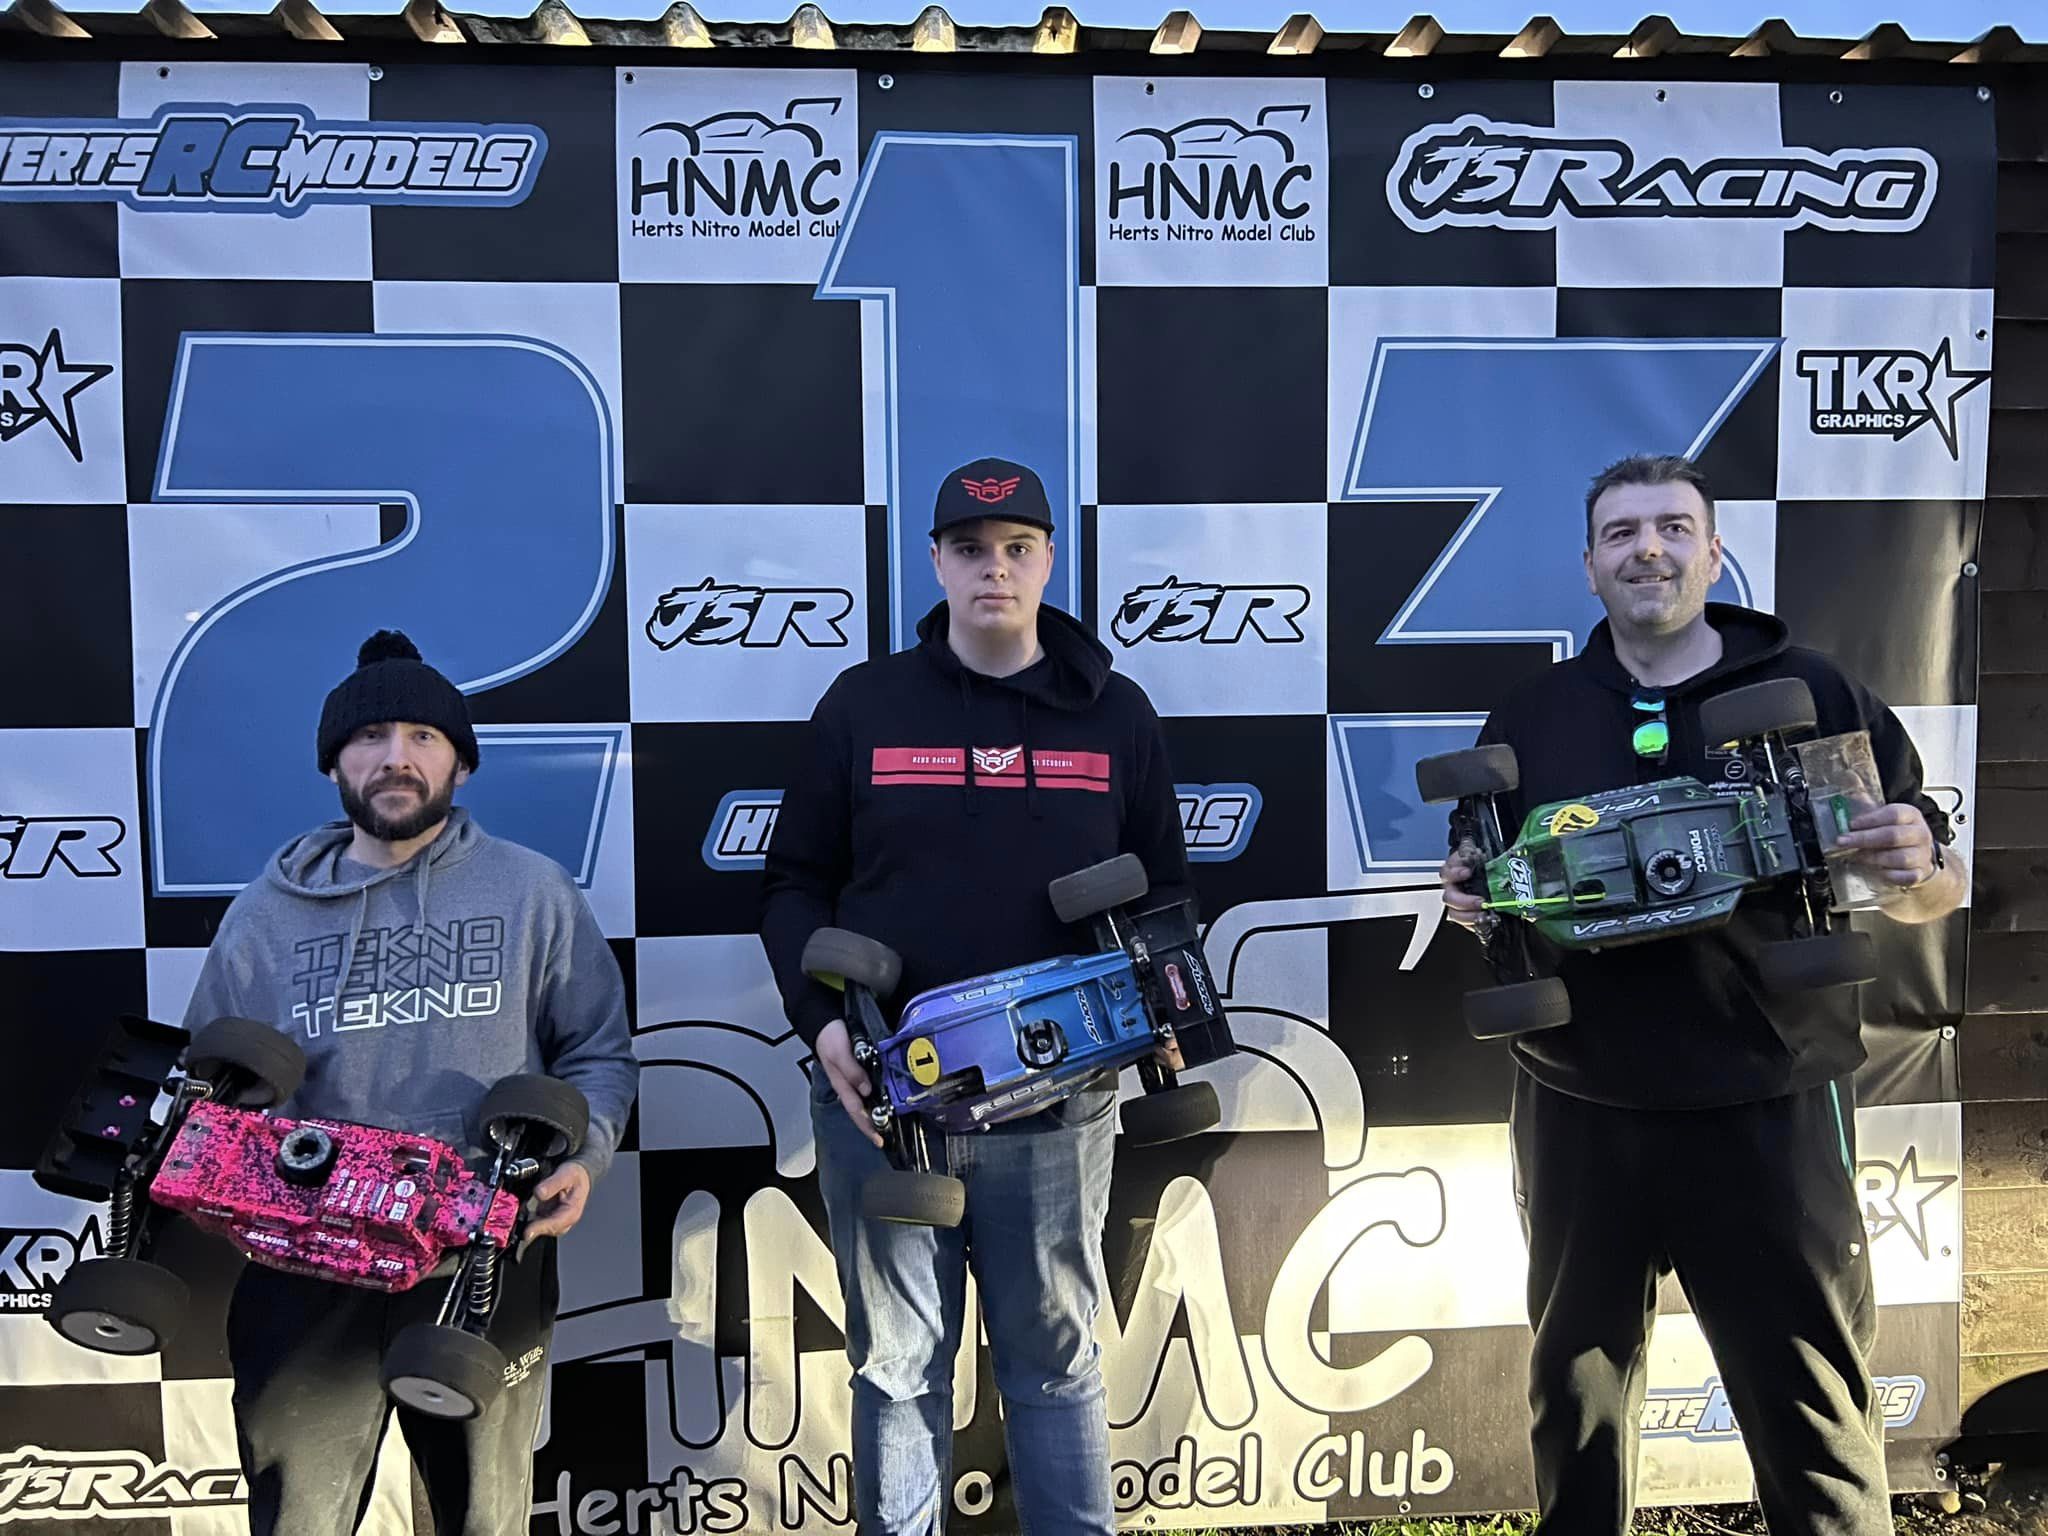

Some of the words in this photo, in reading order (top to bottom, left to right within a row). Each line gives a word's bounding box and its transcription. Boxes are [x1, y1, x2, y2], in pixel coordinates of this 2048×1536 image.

[631, 156, 842, 217] HNMC
[1109, 161, 1312, 221] HNMC
[632, 220, 684, 237] Herts
[692, 220, 740, 237] Nitro
[749, 220, 800, 237] Model
[1109, 224, 1159, 241] Herts
[1167, 224, 1213, 241] Nitro
[1221, 224, 1272, 241] Model
[1280, 224, 1316, 241] Club
[814, 131, 1080, 655] 1
[1802, 356, 1929, 411] TKR
[1816, 413, 1905, 428] GRAPHICS
[150, 331, 630, 898] 2
[1688, 829, 1708, 873] PDMCC
[292, 980, 502, 1038] TEKNO
[0, 1235, 75, 1290] KR
[0, 1293, 53, 1308] PHICS
[1110, 1434, 1262, 1513] odel
[1294, 1428, 1456, 1503] Club
